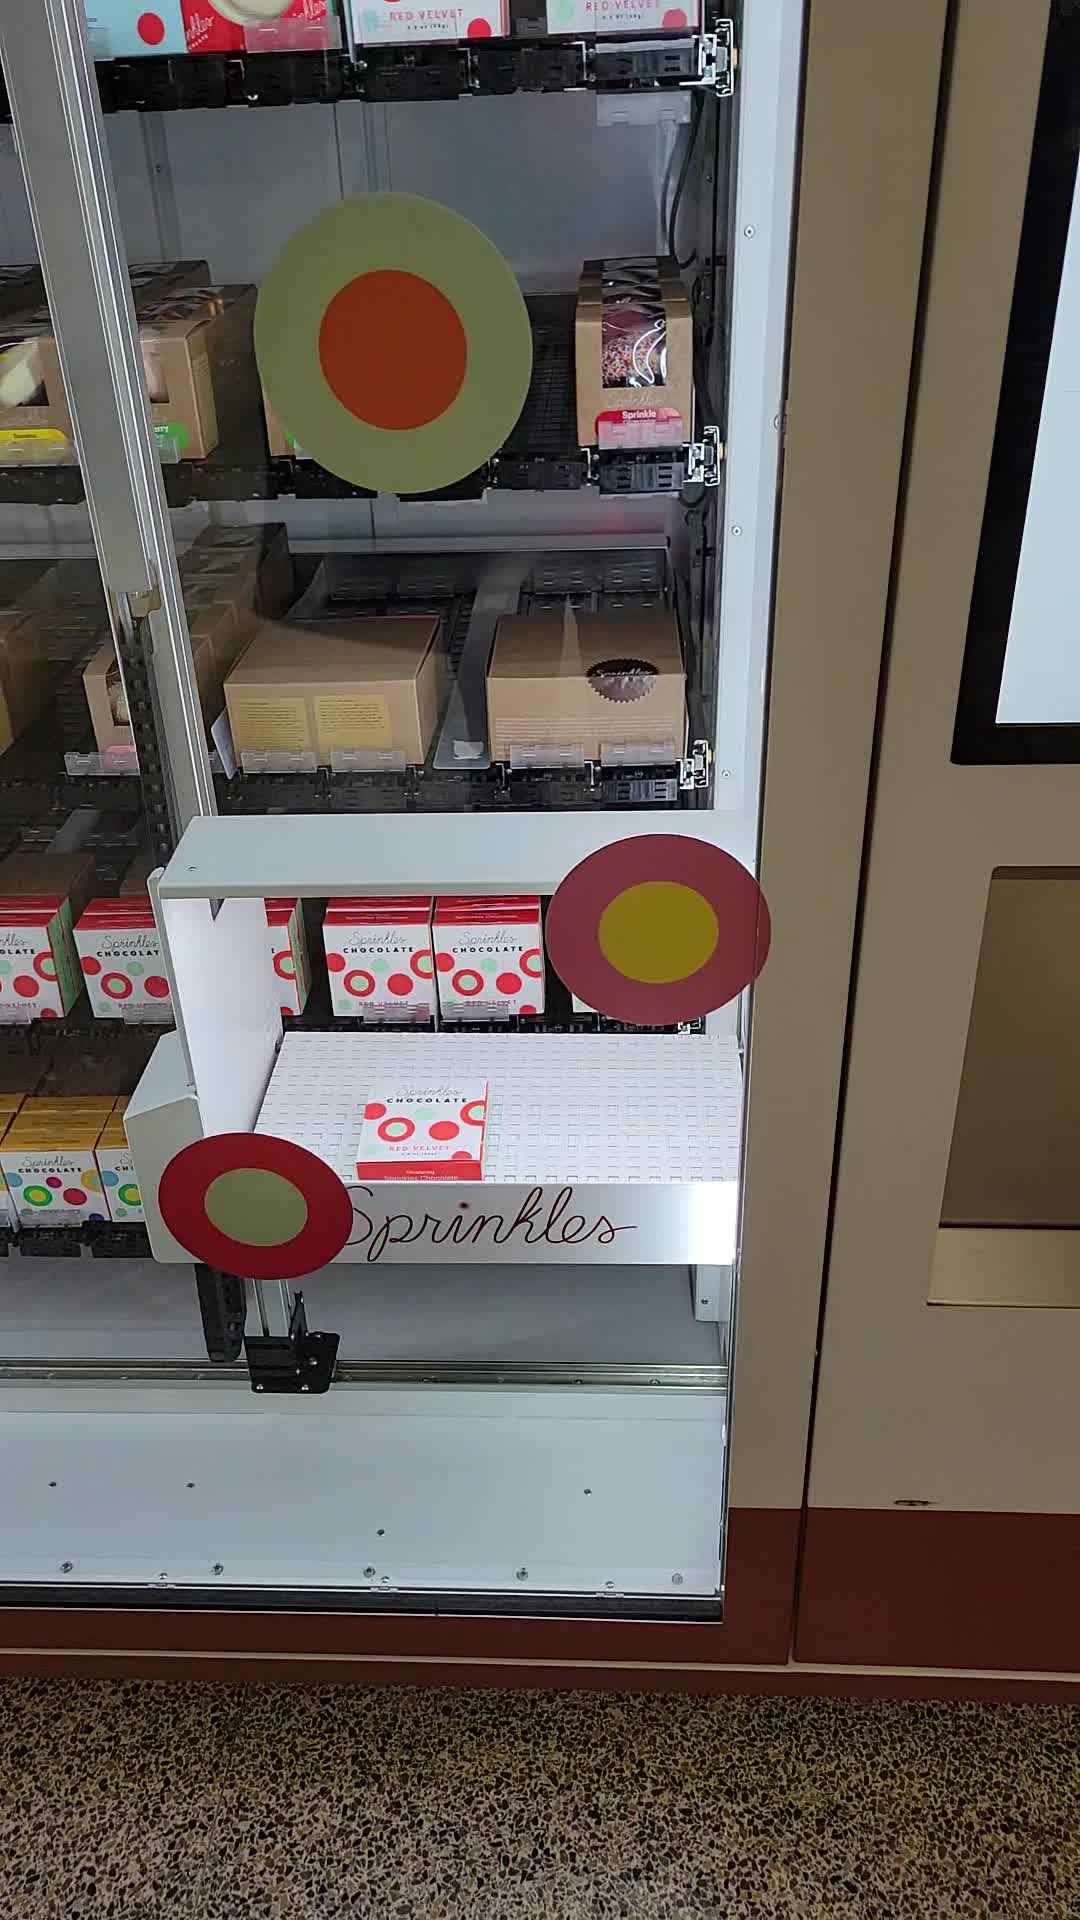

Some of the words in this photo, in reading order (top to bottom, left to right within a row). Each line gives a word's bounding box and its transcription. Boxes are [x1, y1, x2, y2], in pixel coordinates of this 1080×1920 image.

[586, 1, 609, 12] RED
[615, 0, 660, 10] VELVET
[389, 11, 413, 21] RED
[418, 8, 464, 21] VELVET
[622, 410, 657, 419] Sprinkle
[101, 934, 160, 950] Sprinkles
[348, 930, 408, 947] Sprinkles
[459, 929, 518, 947] Sprinkles
[96, 949, 160, 957] CHOCOLAT
[342, 946, 415, 954] CHOCOLATE
[452, 945, 524, 953] CHOCOLATE
[22, 1155, 76, 1169] Sprinkles
